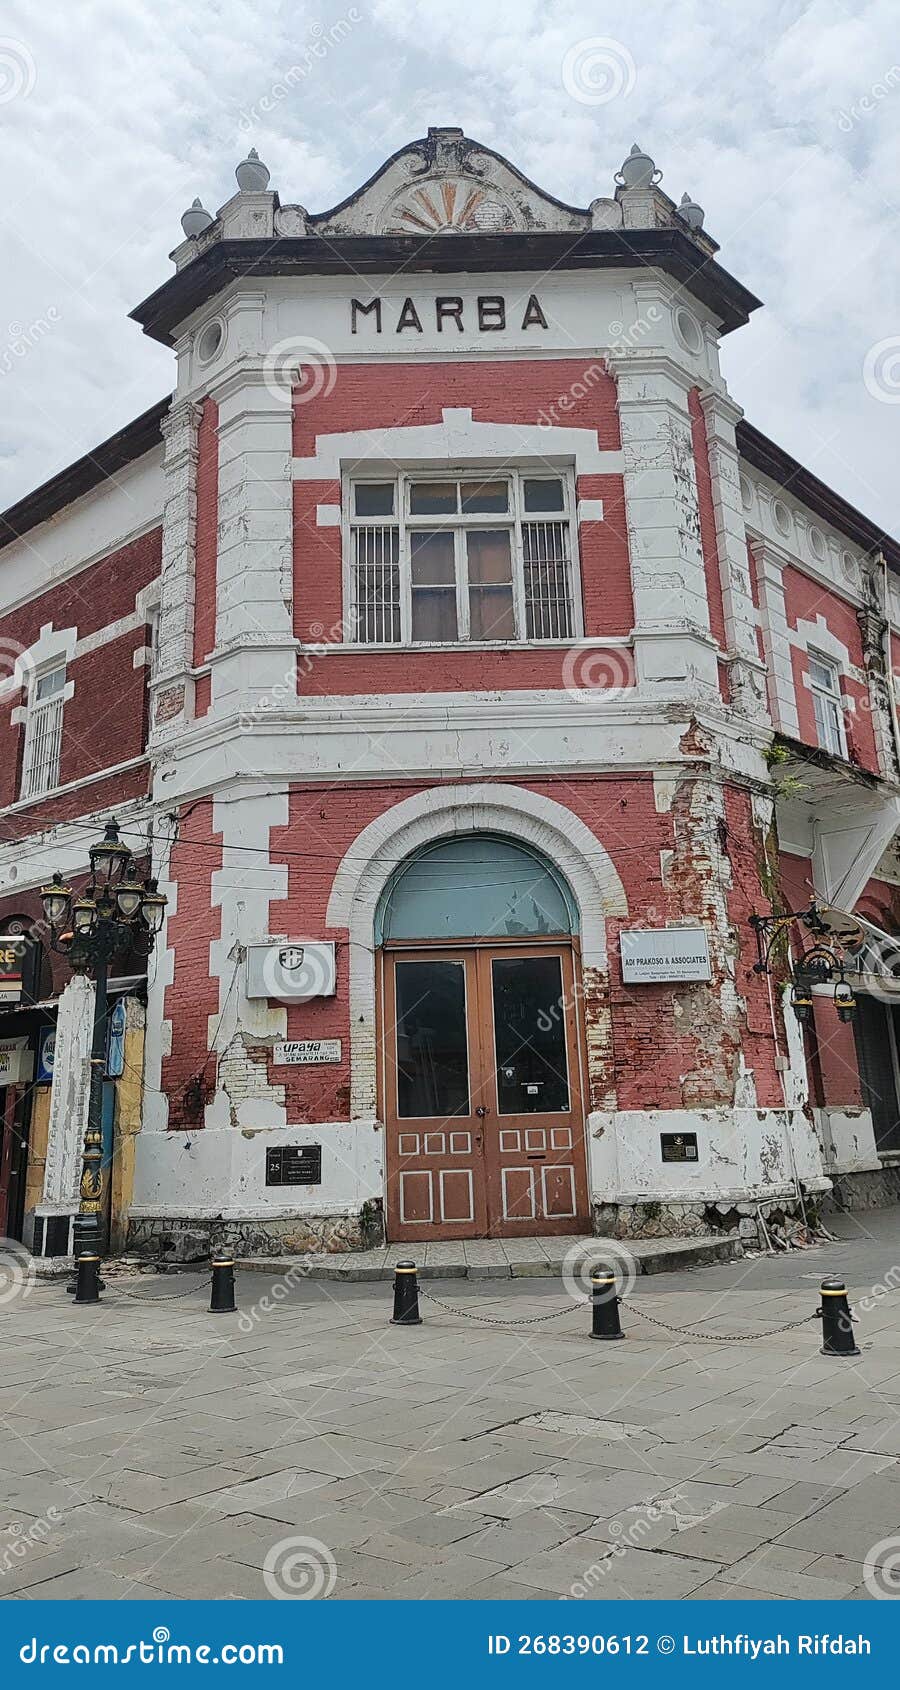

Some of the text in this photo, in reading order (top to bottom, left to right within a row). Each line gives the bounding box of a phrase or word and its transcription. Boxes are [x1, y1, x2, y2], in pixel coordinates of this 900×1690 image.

[351, 294, 549, 334] MARBA
[625, 958, 636, 967] ADI
[636, 957, 664, 966] PRAKOSO
[671, 955, 707, 965] ASSOCIATES
[270, 1163, 280, 1171] 25
